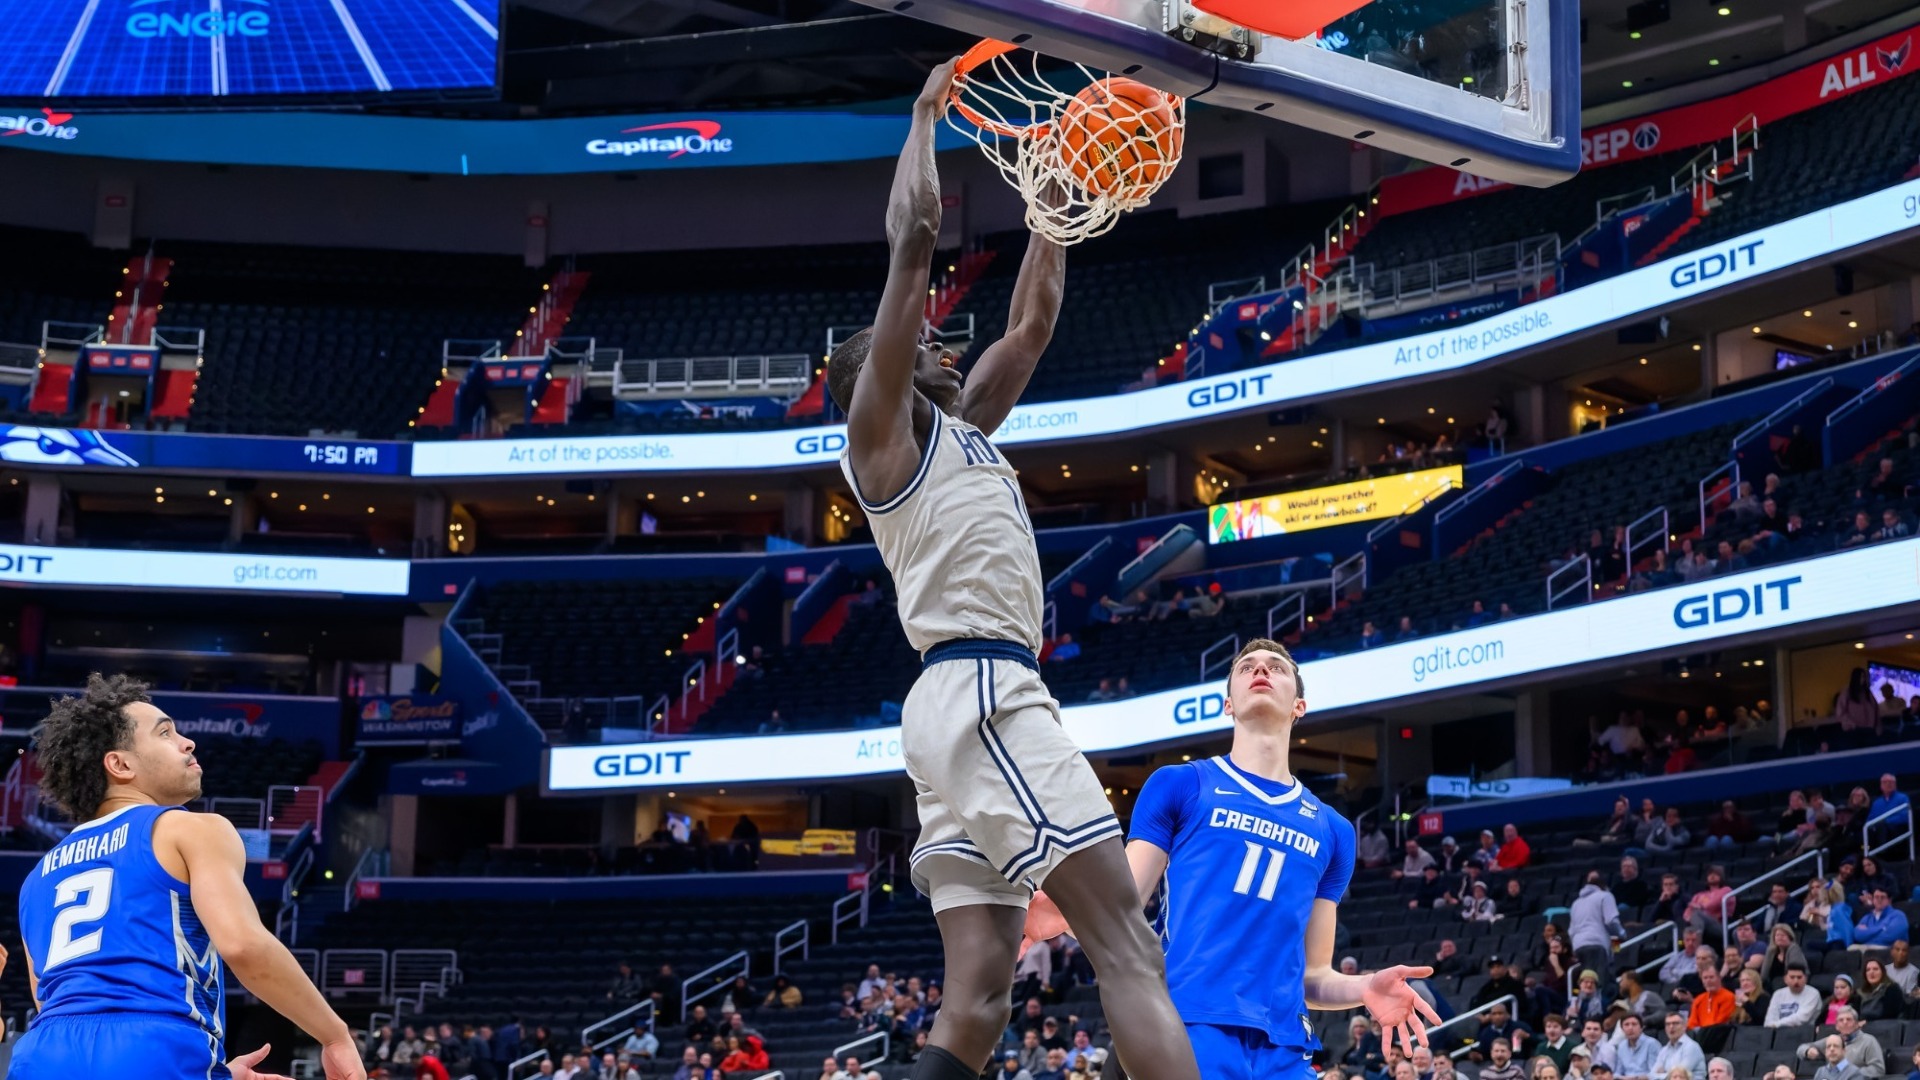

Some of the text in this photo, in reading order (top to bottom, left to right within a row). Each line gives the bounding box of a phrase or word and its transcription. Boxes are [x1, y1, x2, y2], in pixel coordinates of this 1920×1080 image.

[1819, 51, 1876, 98] ALL
[1453, 171, 1504, 196] AL
[1670, 239, 1764, 288] GDIT
[1394, 345, 1421, 366] Art
[1426, 336, 1446, 360] of
[1451, 332, 1478, 355] the
[1482, 309, 1553, 351] possible.
[1187, 373, 1272, 408] GDIT
[999, 411, 1078, 436] gdit.com
[304, 445, 378, 465] 7:50 PM
[508, 442, 674, 463] Art of the possible.
[1287, 490, 1374, 510] Would you rather
[1284, 513, 1300, 523] ski
[1302, 513, 1311, 521] or
[233, 563, 318, 583] gdit.com
[1673, 575, 1802, 629] GDIT
[1413, 640, 1504, 682] gdit.com
[594, 751, 691, 777] GDIT
[856, 739, 882, 759] Art
[1209, 808, 1320, 858] CREIGHTON
[1423, 818, 1439, 831] 112
[41, 823, 130, 878] NEMBHARD
[1232, 840, 1287, 901] 11
[42, 867, 114, 974] 2
